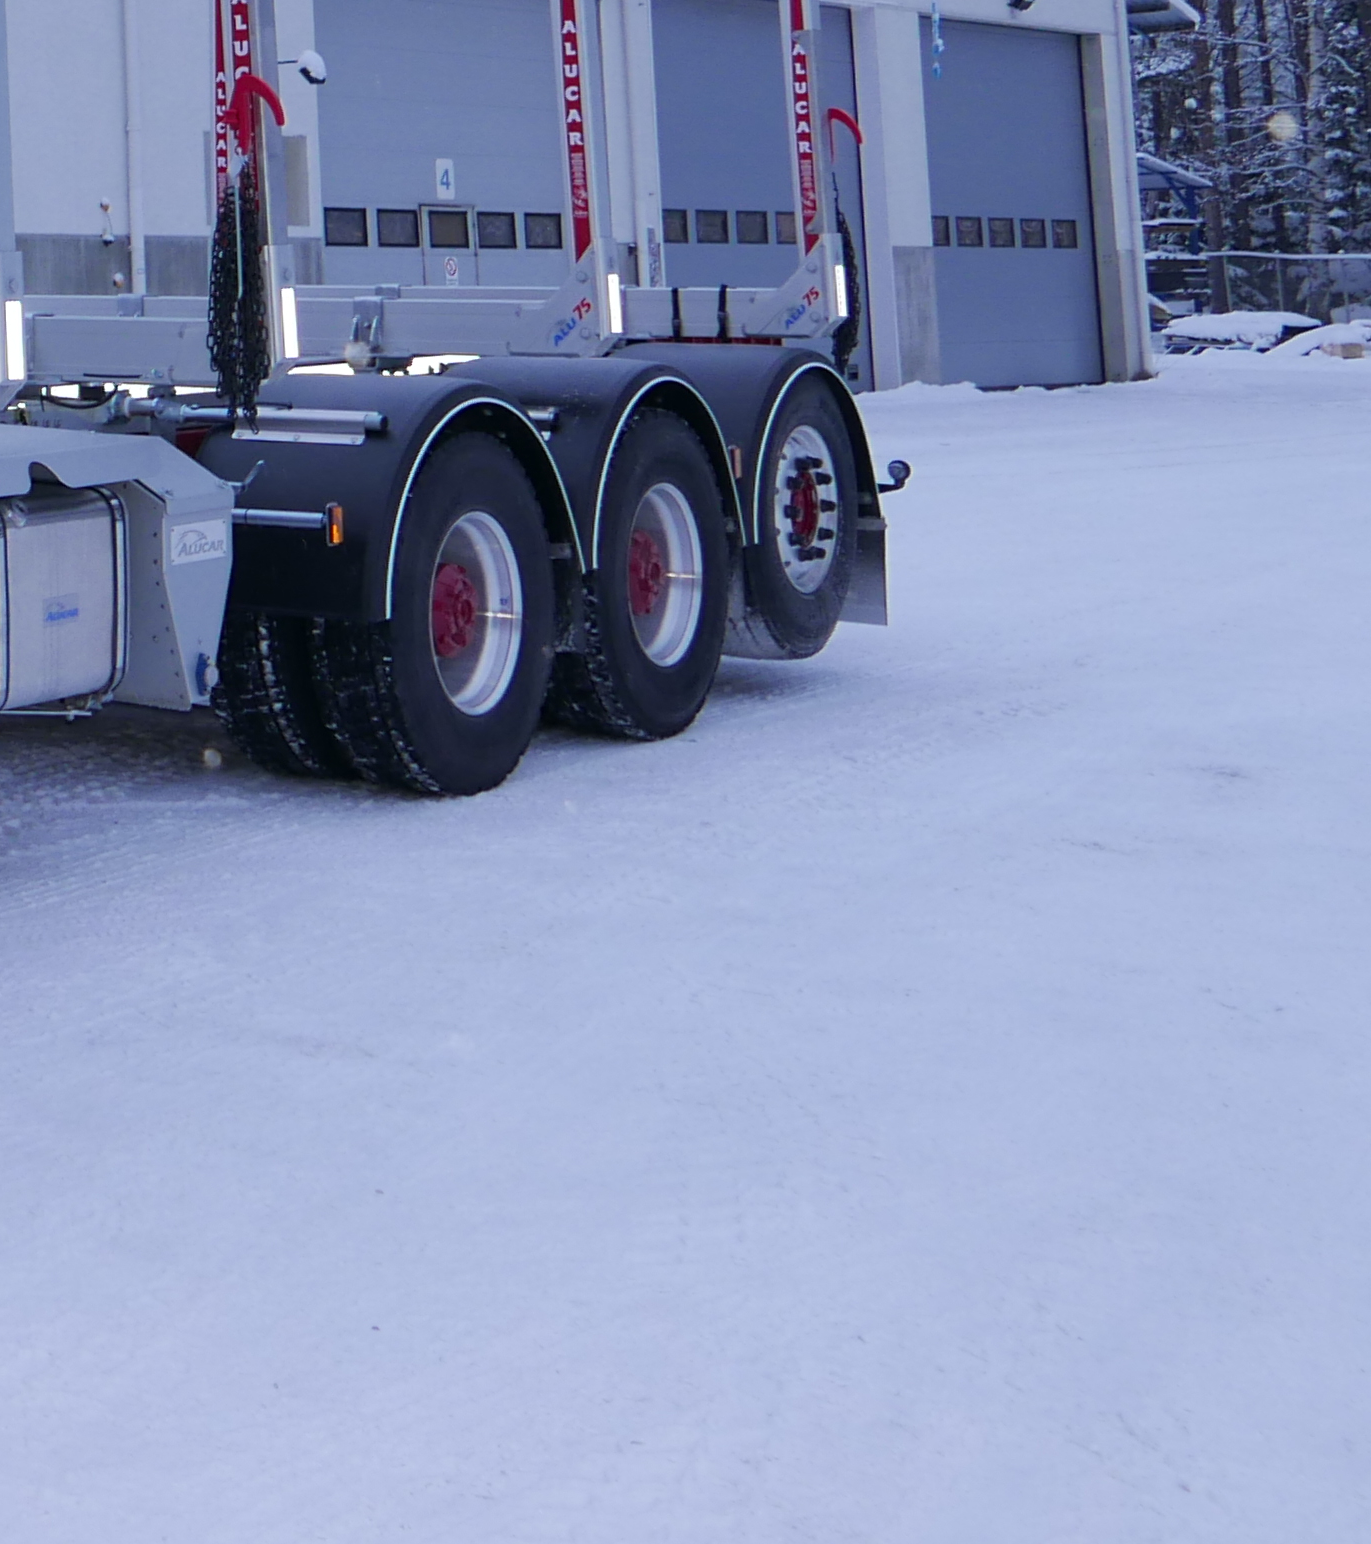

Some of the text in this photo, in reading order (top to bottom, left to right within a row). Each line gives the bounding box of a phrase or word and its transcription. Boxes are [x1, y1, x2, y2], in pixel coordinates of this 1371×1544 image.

[562, 20, 584, 146] ALUCAR
[792, 43, 813, 154] ALUCAR
[216, 71, 228, 168] ALUCAR
[440, 167, 451, 191] 4
[802, 285, 820, 307] 75
[553, 297, 592, 347] ALU 75
[178, 539, 225, 558] ALUCAR
